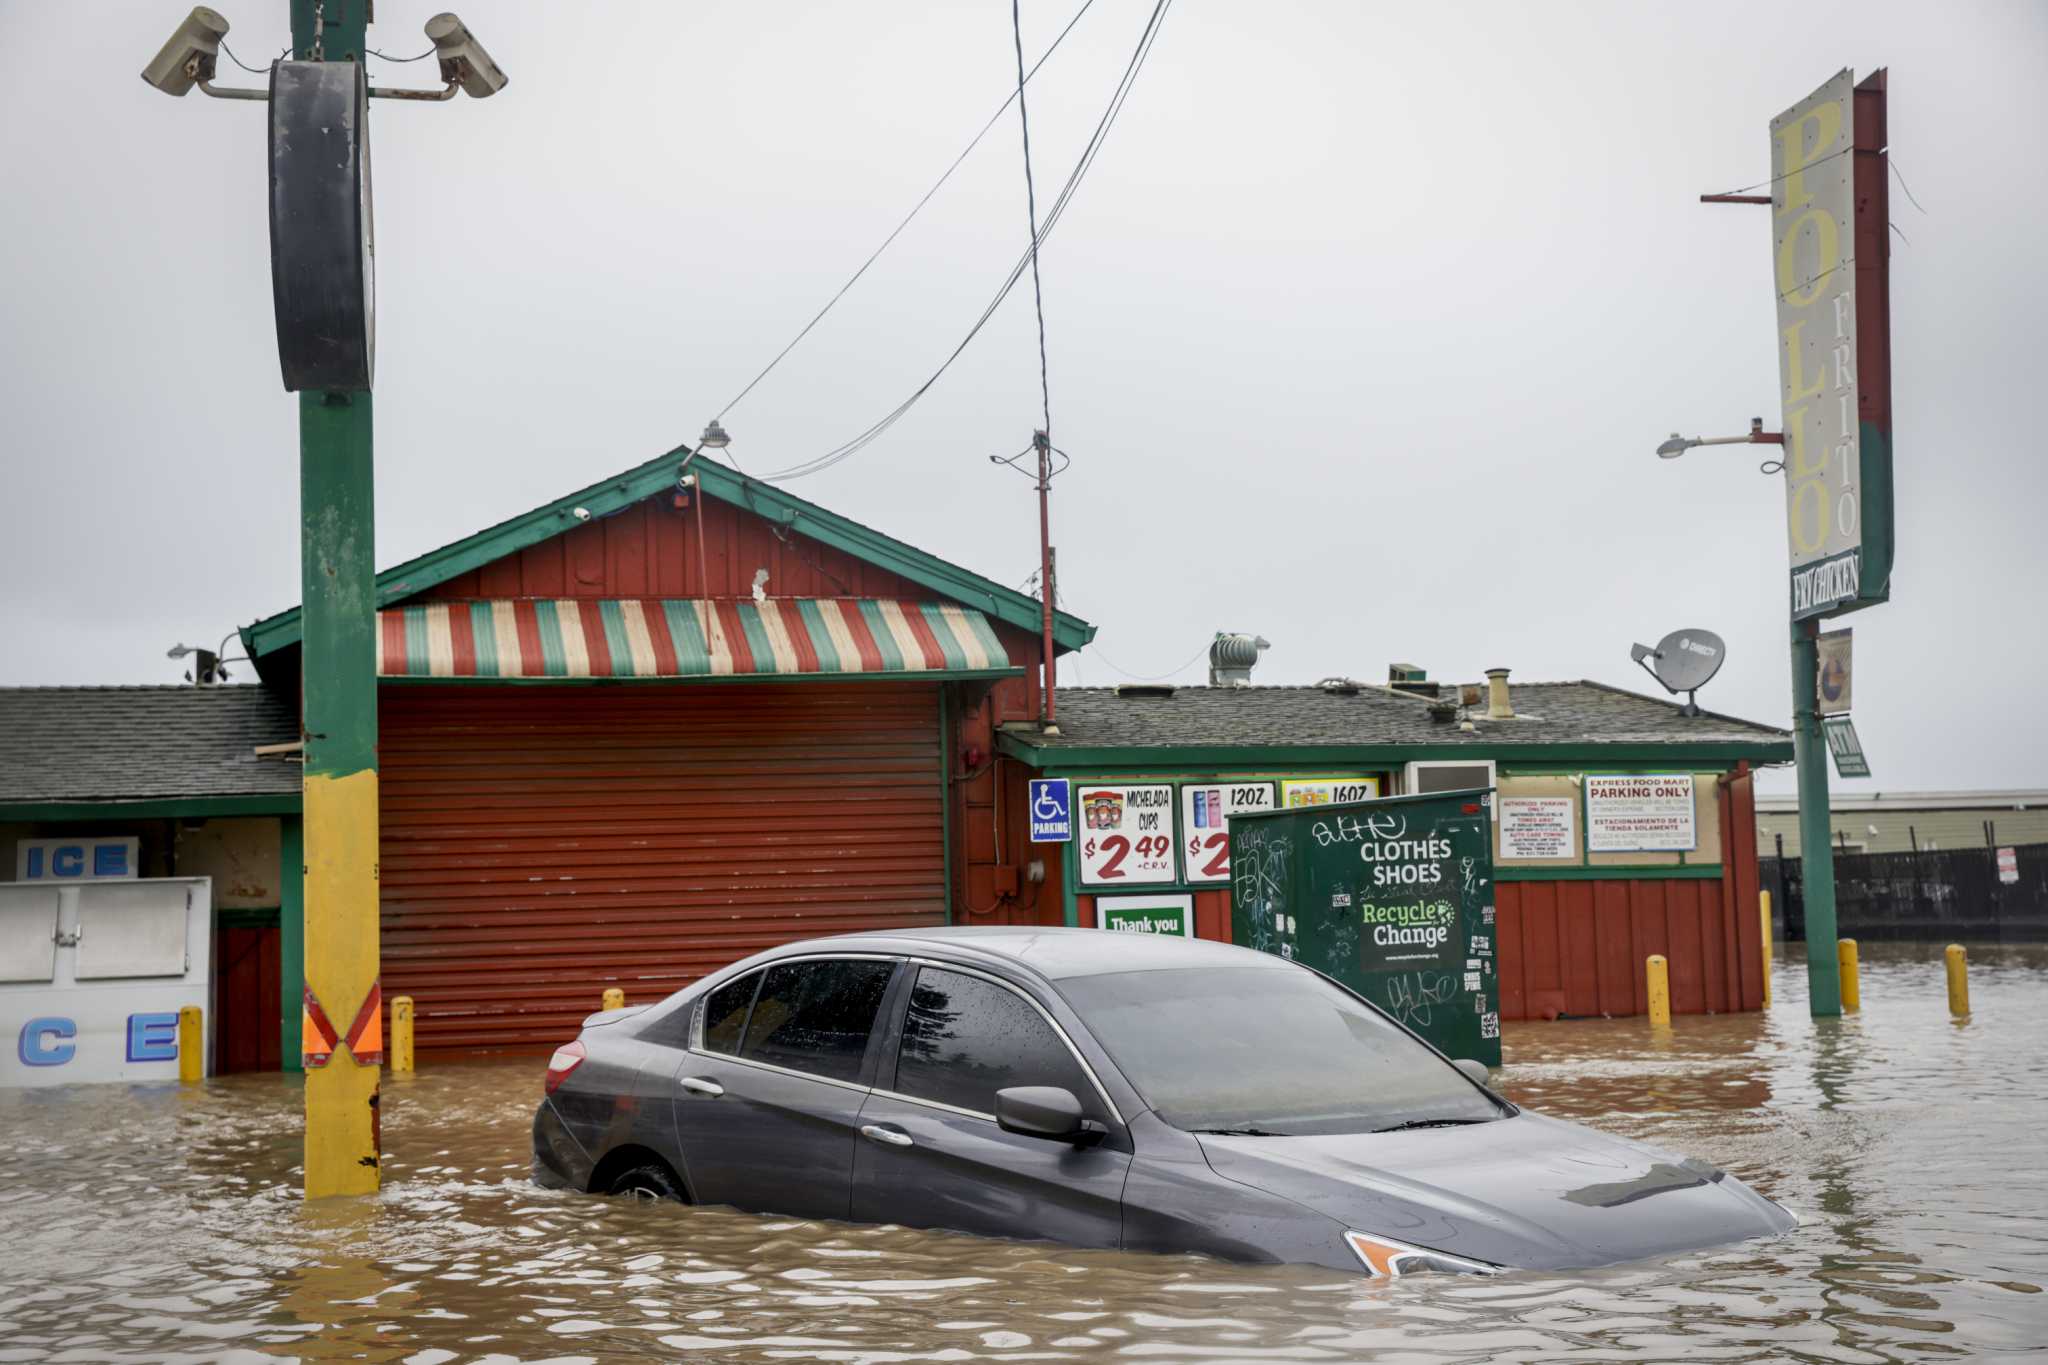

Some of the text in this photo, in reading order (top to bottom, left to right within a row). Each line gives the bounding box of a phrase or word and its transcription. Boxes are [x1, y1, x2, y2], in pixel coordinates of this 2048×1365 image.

[1775, 101, 1842, 553] POLLO
[1832, 291, 1858, 537] FRITO
[1127, 790, 1169, 808] MICHELADA
[1591, 787, 1689, 798] PARKING ONLY
[1034, 822, 1068, 834] PARKING
[1139, 812, 1158, 831] CUPS
[27, 844, 129, 879] ICE
[1360, 839, 1452, 862] CLOTHES
[1362, 900, 1437, 926] Recycle
[1112, 917, 1178, 935] Thank you
[1373, 924, 1448, 948] Change
